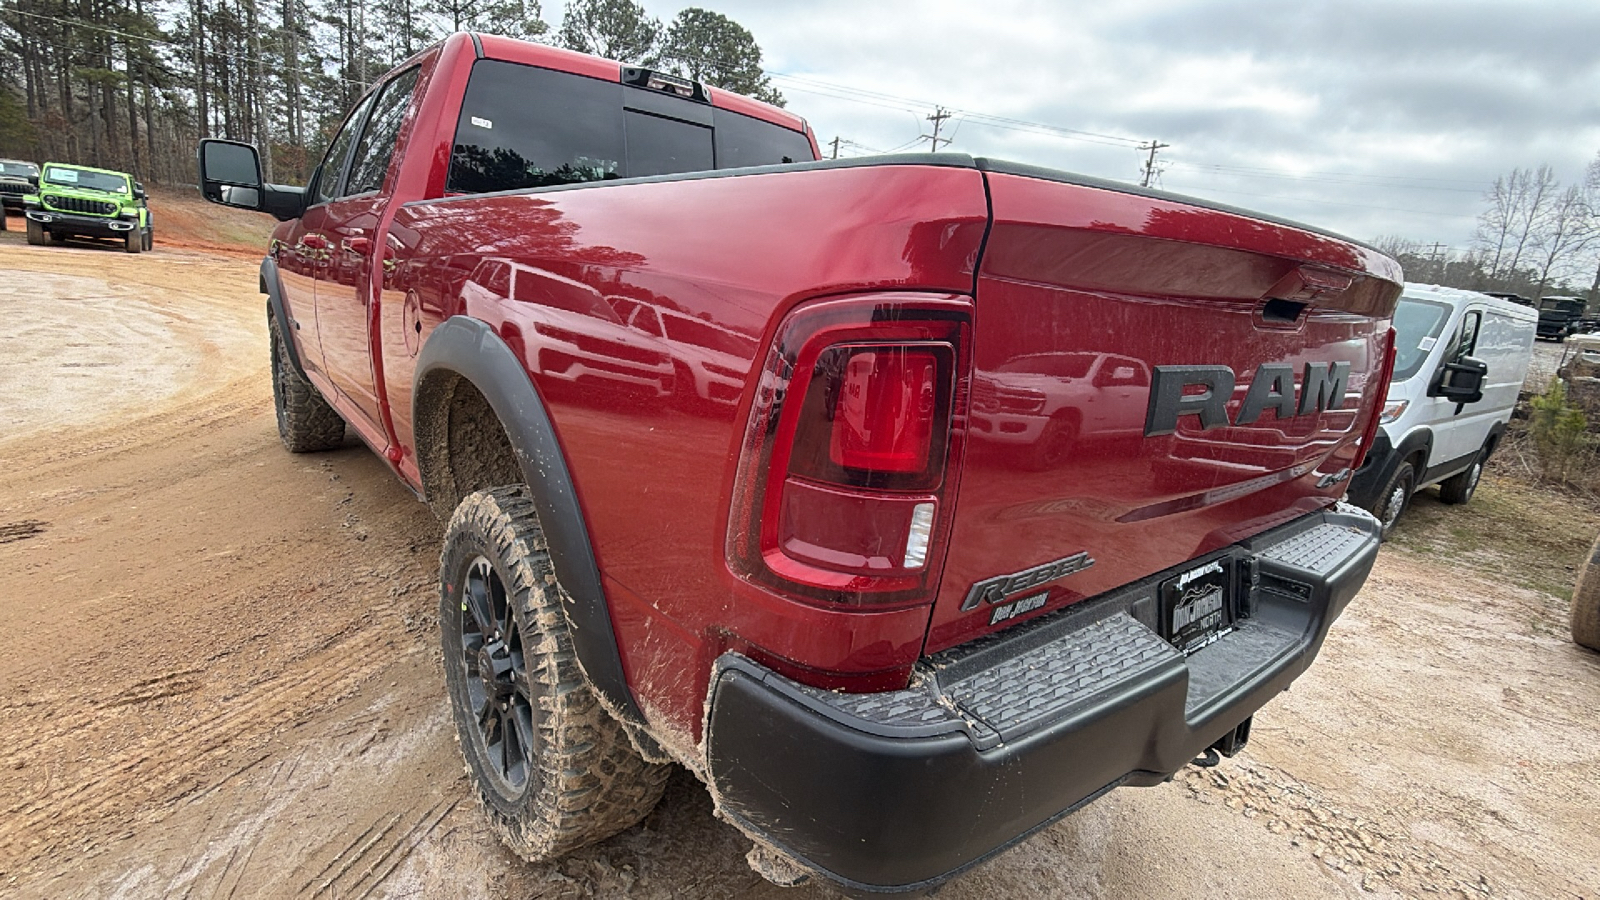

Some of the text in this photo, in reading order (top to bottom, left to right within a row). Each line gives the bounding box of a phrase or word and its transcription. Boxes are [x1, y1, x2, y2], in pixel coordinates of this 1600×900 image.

[1144, 361, 1350, 438] RAM
[958, 550, 1095, 612] REBEL
[1172, 604, 1191, 635] DON
[1189, 589, 1223, 622] JACKSON
[1200, 609, 1222, 631] NORTH
